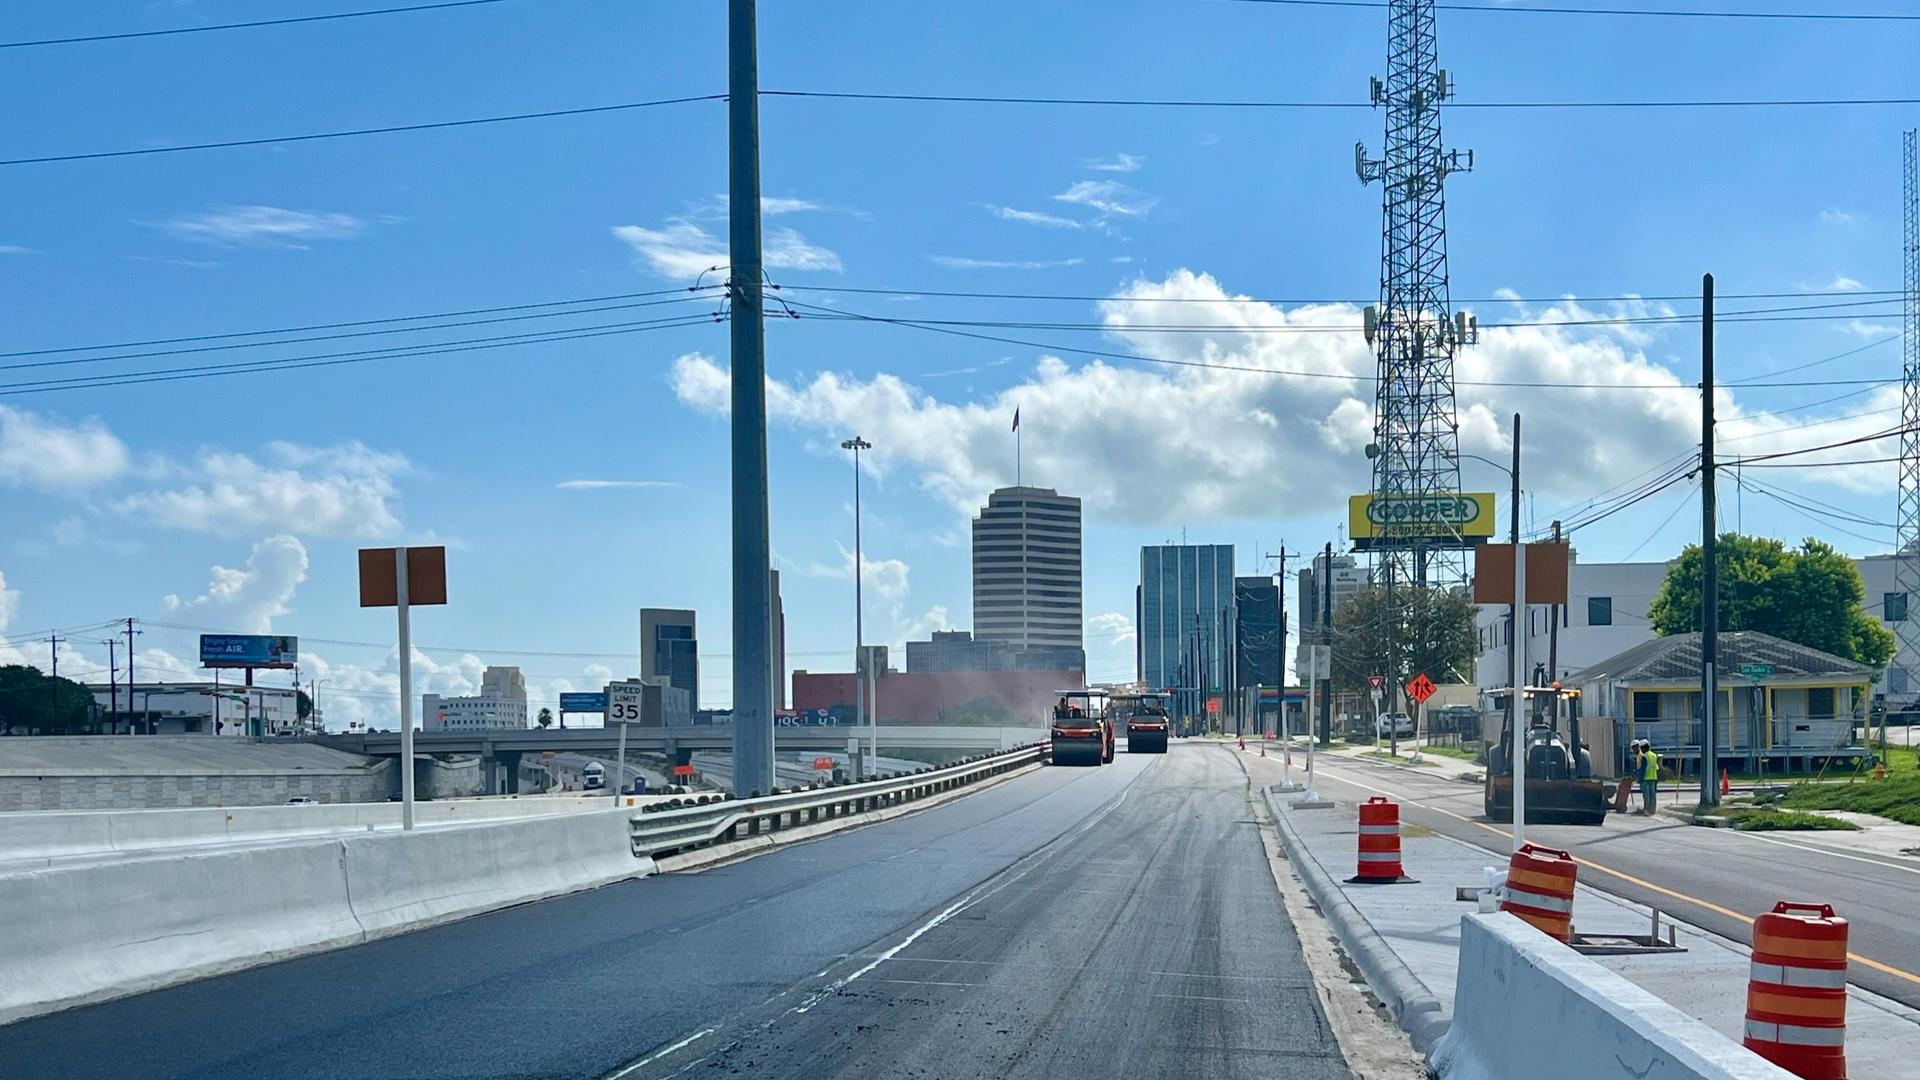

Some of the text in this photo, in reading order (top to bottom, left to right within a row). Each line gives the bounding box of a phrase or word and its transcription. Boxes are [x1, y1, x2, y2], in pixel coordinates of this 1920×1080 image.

[1377, 501, 1469, 519] COOPER
[204, 637, 249, 646] Enjoy Some
[203, 645, 224, 653] Fresh
[612, 685, 641, 694] SPEED
[612, 703, 639, 720] 35
